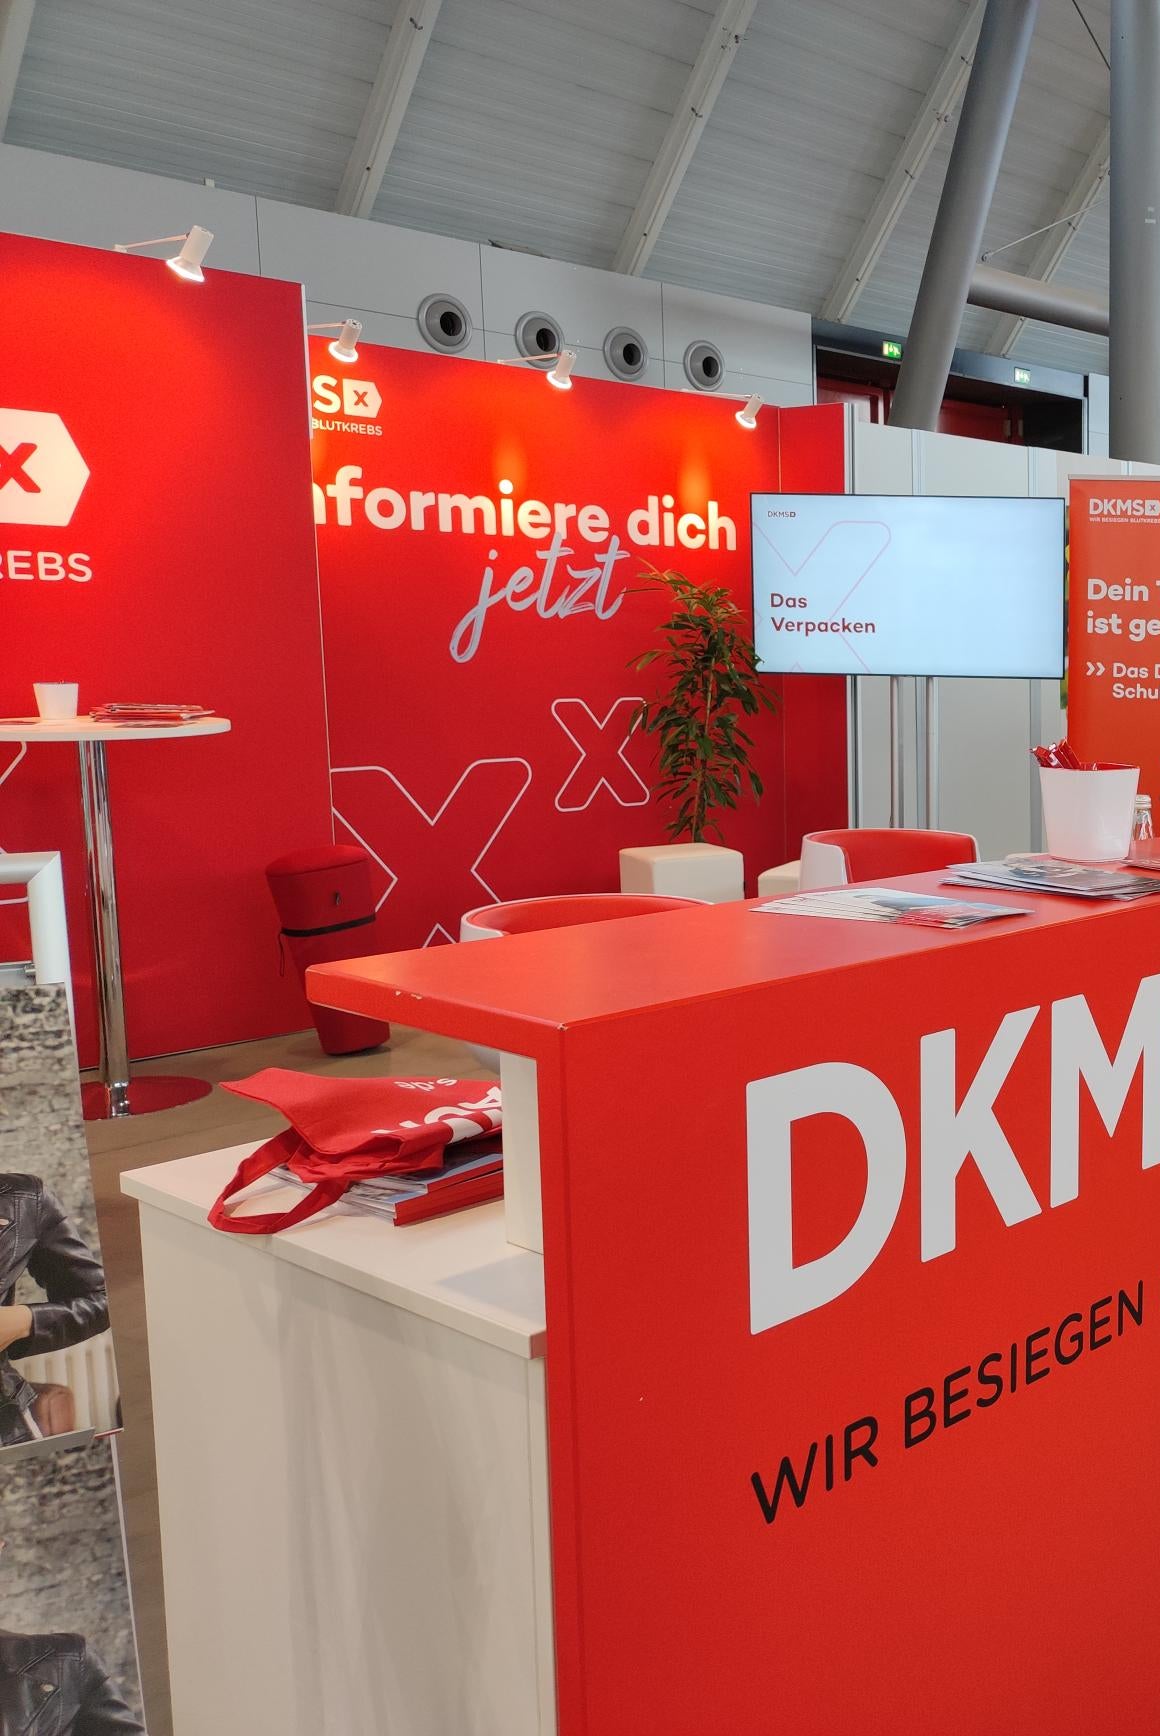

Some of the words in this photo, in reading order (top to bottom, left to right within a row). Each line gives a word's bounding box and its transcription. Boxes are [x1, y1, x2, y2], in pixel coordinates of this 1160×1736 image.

[311, 417, 383, 437] BLUTKREBS
[1089, 498, 1145, 516] DKMS
[627, 494, 737, 551] dich
[449, 531, 631, 663] jetzt
[770, 592, 808, 608] Das
[1087, 577, 1149, 602] Dein
[771, 616, 876, 637] Verpacken
[1087, 611, 1123, 635] ist
[1112, 662, 1149, 679] Das
[750, 1415, 879, 1525] WIR
[903, 1280, 1145, 1449] BESIEGEN
